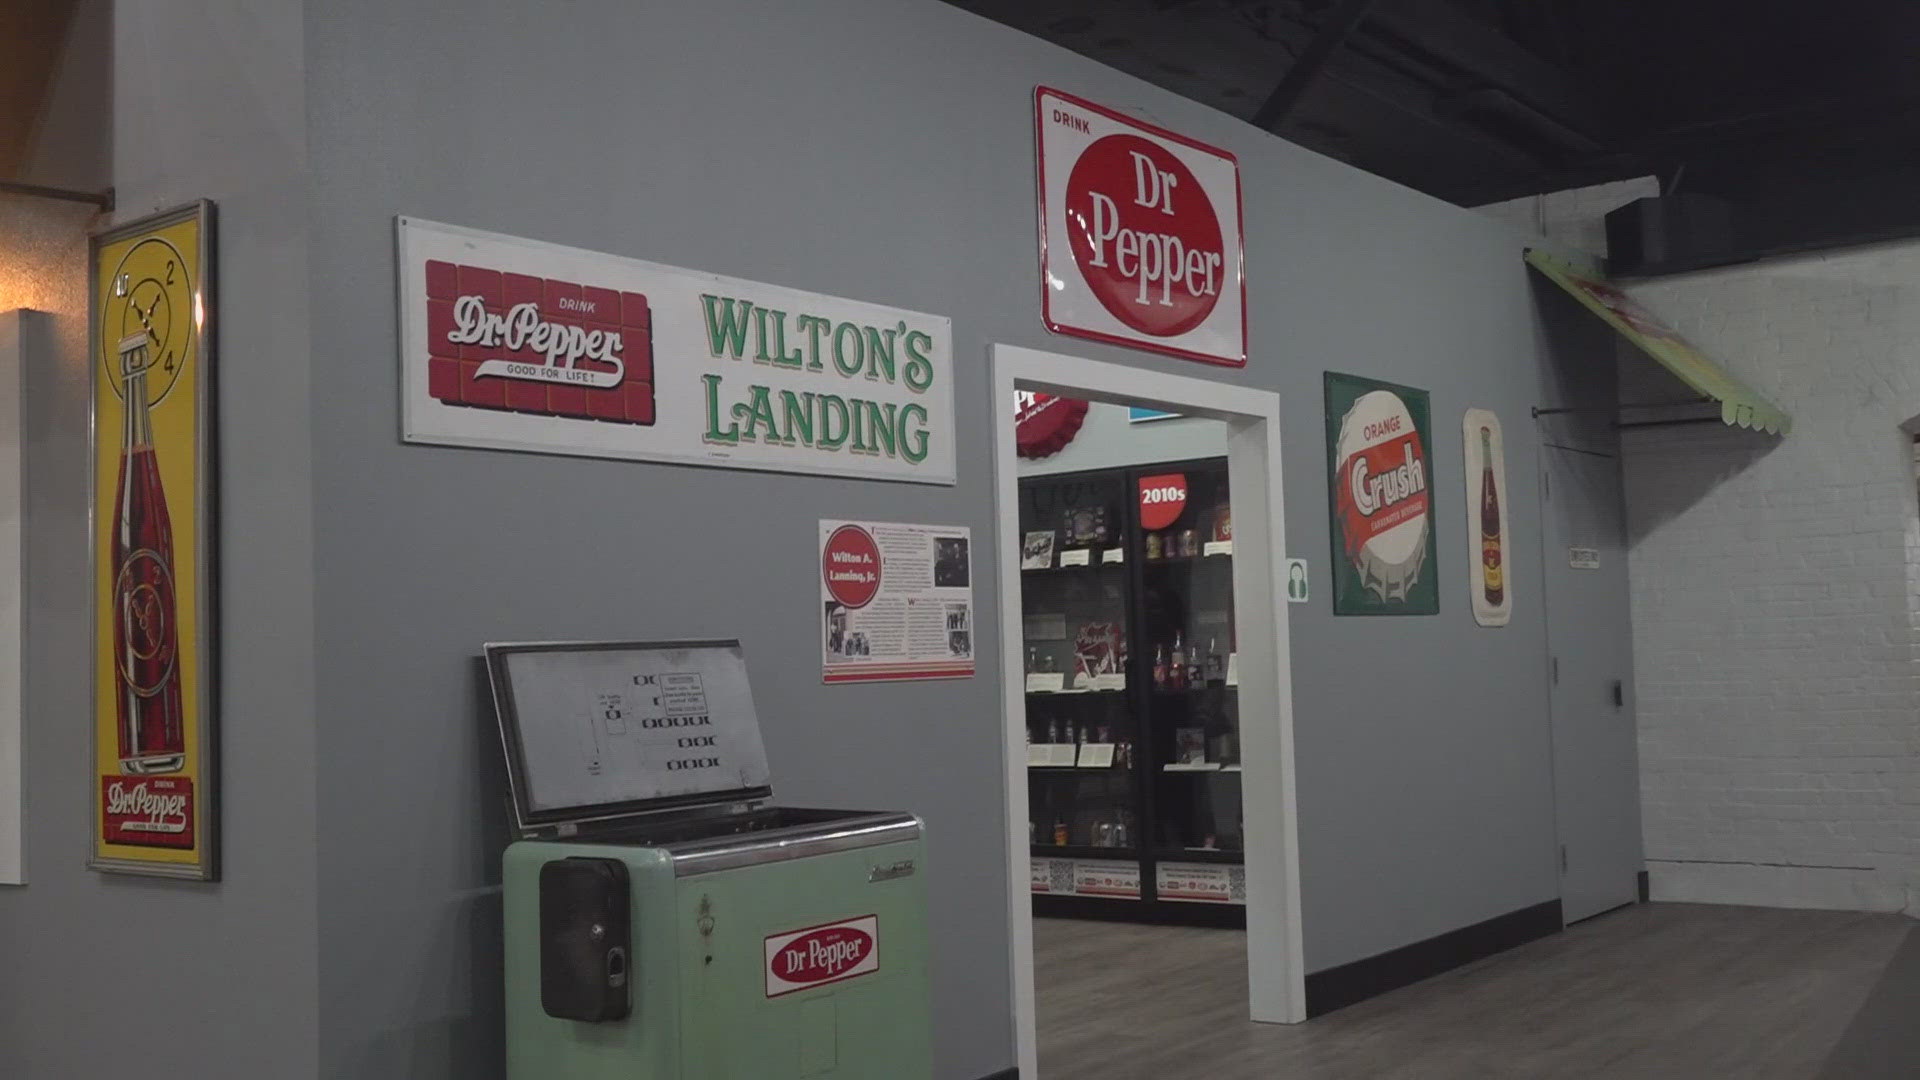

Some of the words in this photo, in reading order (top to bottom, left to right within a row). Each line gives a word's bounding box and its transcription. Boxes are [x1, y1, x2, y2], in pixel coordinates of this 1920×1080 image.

[1053, 109, 1090, 135] DRINK
[1129, 150, 1177, 216] Dr
[1088, 190, 1220, 307] Pepper
[166, 260, 174, 285] 2
[559, 297, 596, 313] DRINK
[447, 295, 501, 347] Dr.
[503, 302, 624, 372] Pepper
[700, 293, 934, 393] WILTON'S
[164, 351, 174, 375] 4
[507, 363, 536, 377] GOOD
[541, 367, 559, 379] FOR
[701, 374, 930, 466] LANDING
[1363, 415, 1400, 441] ORANGE
[1351, 441, 1425, 517] Crush
[1142, 486, 1186, 504] 2010s
[831, 551, 861, 564] Wilton
[131, 782, 186, 824] Pepper
[785, 949, 806, 974] Dr
[808, 938, 862, 975] Pepper
